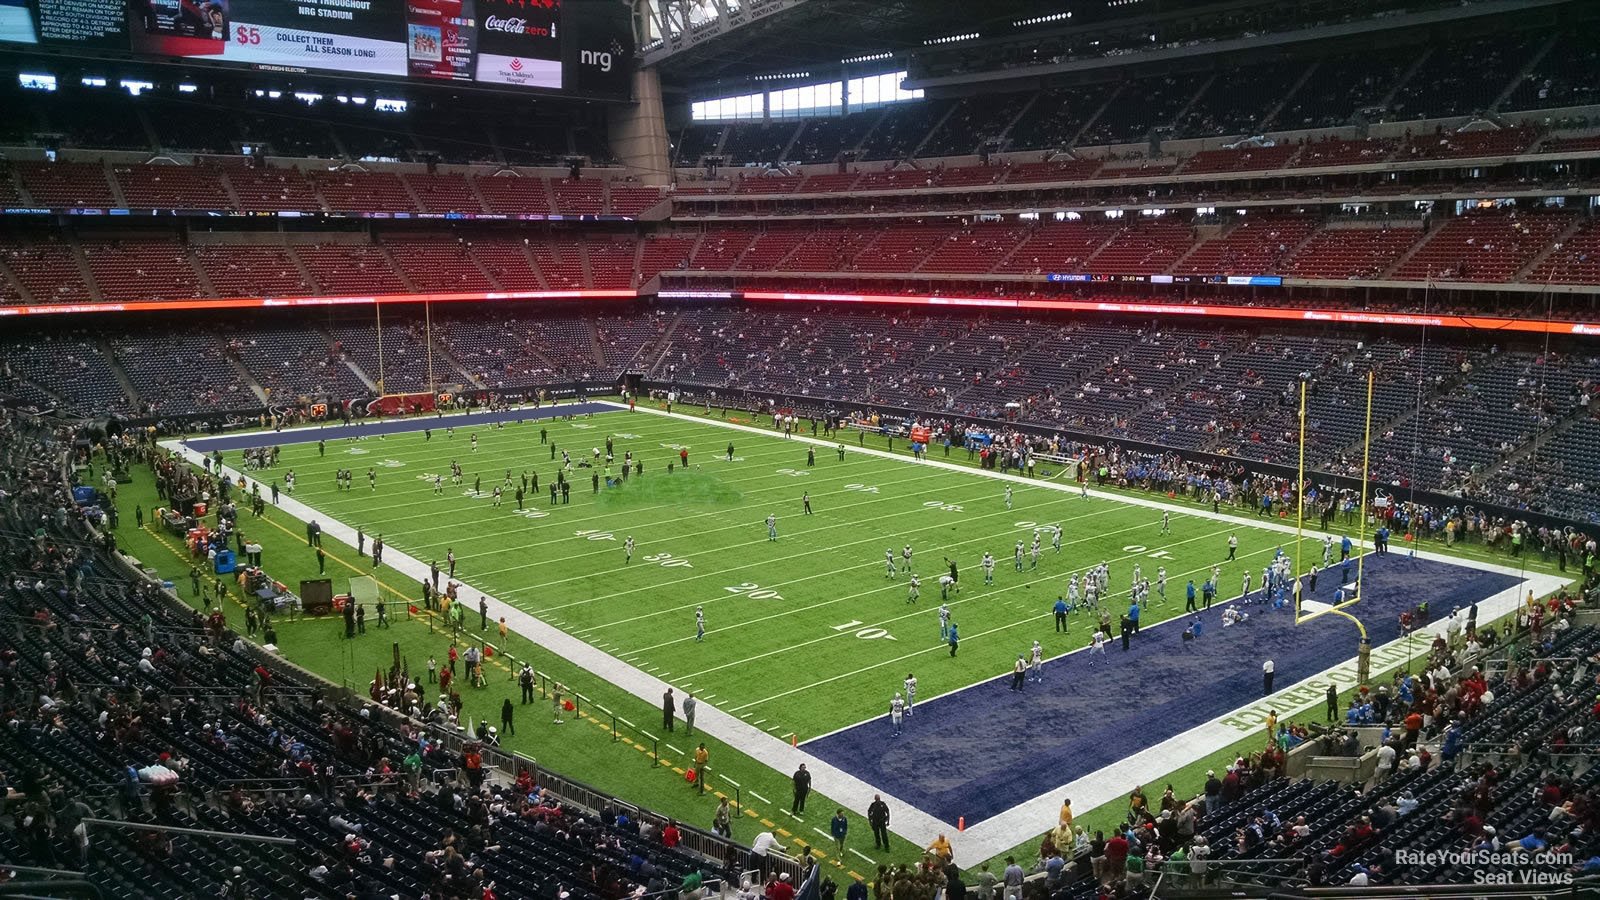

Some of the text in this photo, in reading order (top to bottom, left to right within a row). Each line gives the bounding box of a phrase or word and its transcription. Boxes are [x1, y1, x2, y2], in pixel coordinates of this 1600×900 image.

[320, 0, 371, 10] THROUGHOUT
[298, 6, 353, 20] NRG STADIUM
[237, 25, 261, 46] $5
[525, 26, 549, 37] zero
[276, 33, 334, 46] COLLECT THEM
[305, 44, 376, 58] ALL SEASON LONG!
[581, 50, 612, 72] nrg
[642, 553, 688, 567] 30
[723, 582, 778, 599] 20
[829, 619, 888, 639] 10
[1218, 680, 1329, 732] SERVICE
